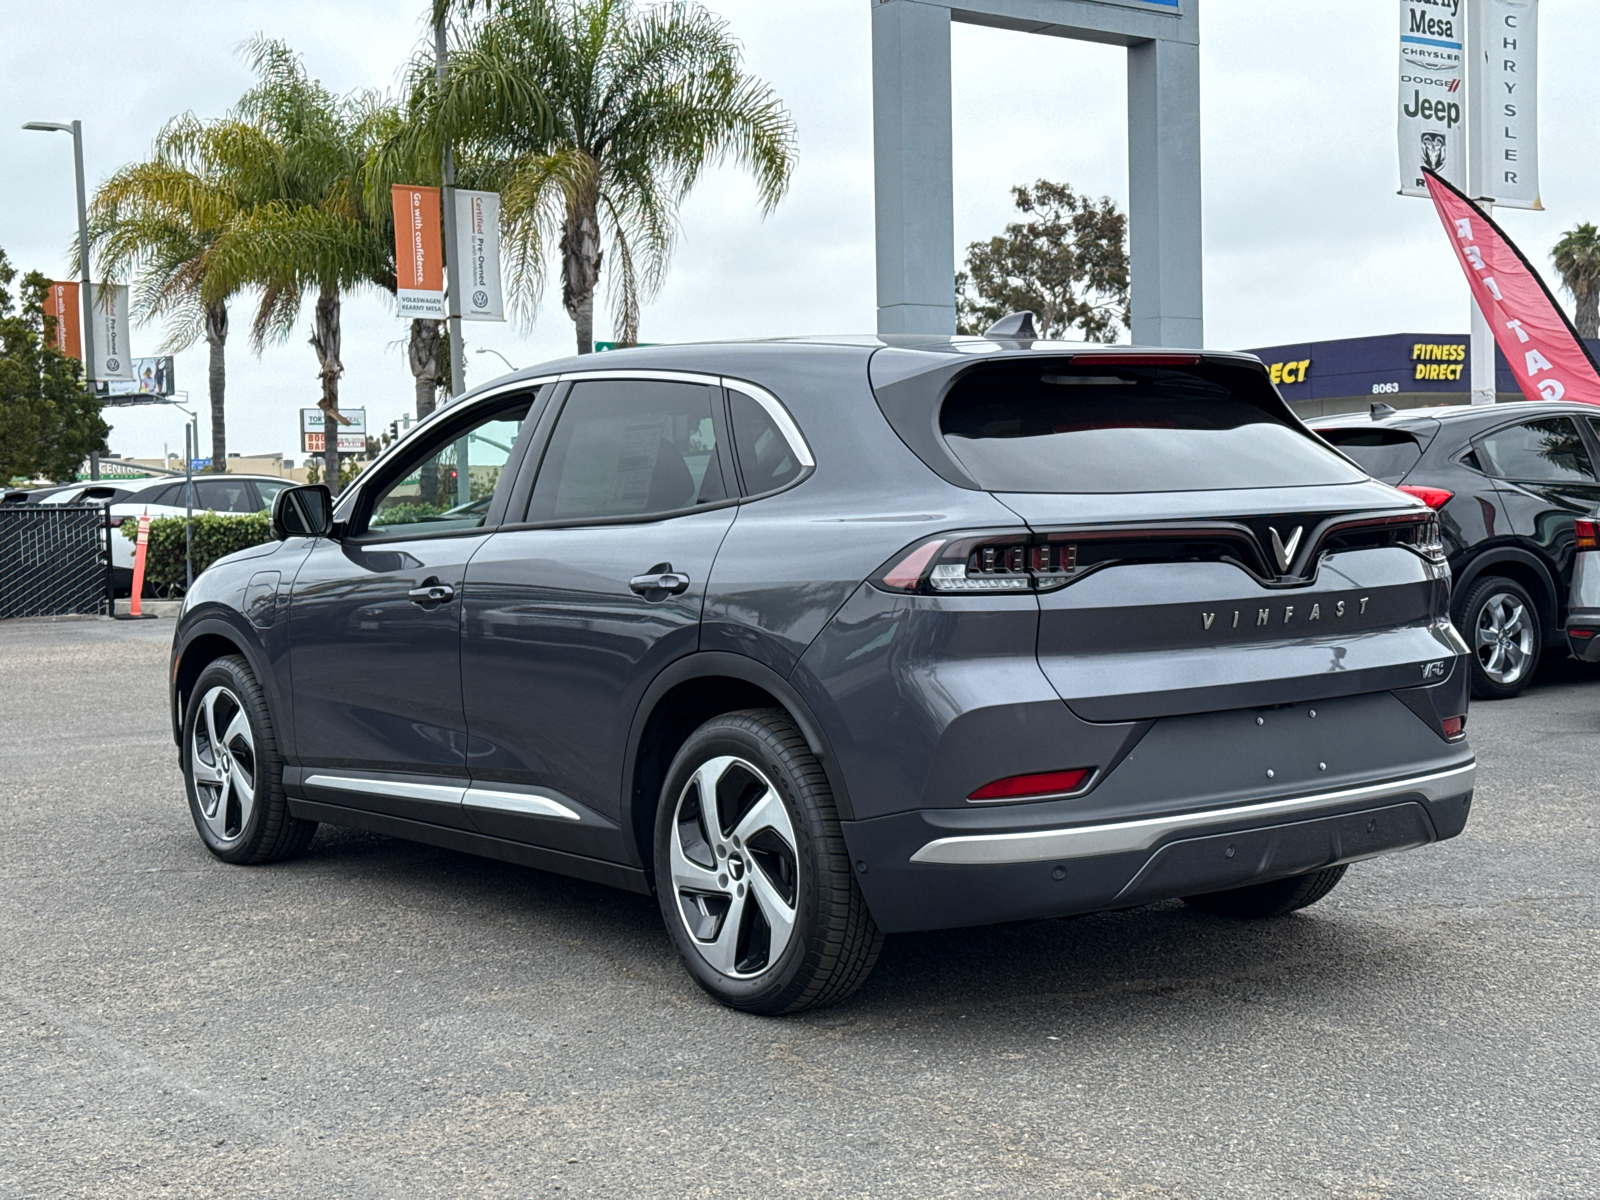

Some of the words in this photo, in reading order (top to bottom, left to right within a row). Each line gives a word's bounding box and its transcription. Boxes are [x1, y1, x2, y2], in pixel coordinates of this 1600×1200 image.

[1409, 8, 1453, 38] Mesa
[1402, 47, 1460, 62] CHRYSLER
[1401, 75, 1452, 88] DODGE
[1403, 89, 1460, 129] Jeep
[1503, 15, 1517, 184] CHRYSLER
[414, 192, 421, 207] Go
[414, 209, 423, 229] with
[475, 197, 484, 235] Certified
[477, 238, 486, 286] Pre-Owned
[401, 296, 441, 304] VOLKSWAGEN
[401, 304, 424, 312] KEARNY
[1412, 343, 1466, 361] FITNESS
[1268, 359, 1310, 384] ECT
[1414, 364, 1464, 380] DIRECT
[1372, 382, 1399, 394] 8063
[1202, 596, 1369, 630] VINFAST
